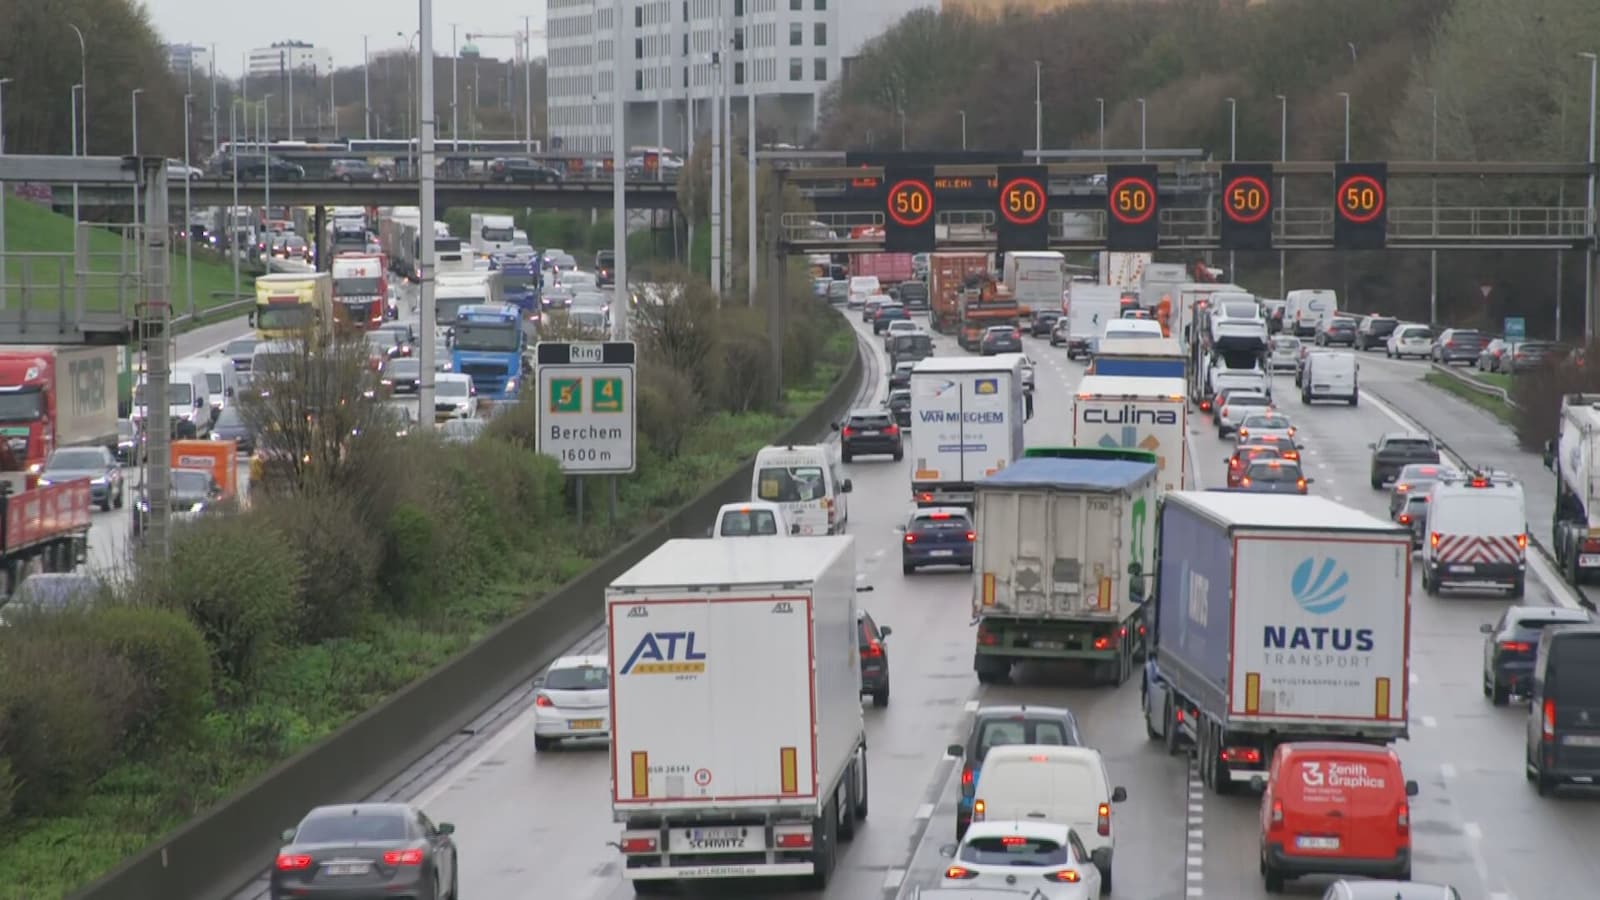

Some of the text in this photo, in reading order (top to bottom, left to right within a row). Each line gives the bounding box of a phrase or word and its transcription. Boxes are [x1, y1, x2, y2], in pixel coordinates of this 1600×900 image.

[897, 192, 923, 213] 50
[1009, 191, 1035, 212] 50
[1119, 190, 1146, 211] 50
[1233, 189, 1260, 210] 50
[1347, 188, 1374, 210] 50
[571, 347, 602, 361] Ring
[561, 381, 613, 404] 5 4
[919, 411, 944, 422] VAN
[1083, 404, 1176, 424] culina
[551, 425, 622, 440] Berchem
[562, 449, 611, 461] 1600 m
[627, 606, 648, 618] ATL
[772, 602, 793, 614] ATL
[1264, 625, 1374, 651] NATUS
[619, 631, 706, 675] ATL
[1264, 652, 1370, 667] TRANSPORT
[1328, 762, 1367, 776] Zenith
[1328, 776, 1385, 789] Graphics
[689, 838, 745, 849] SCHMITZ
